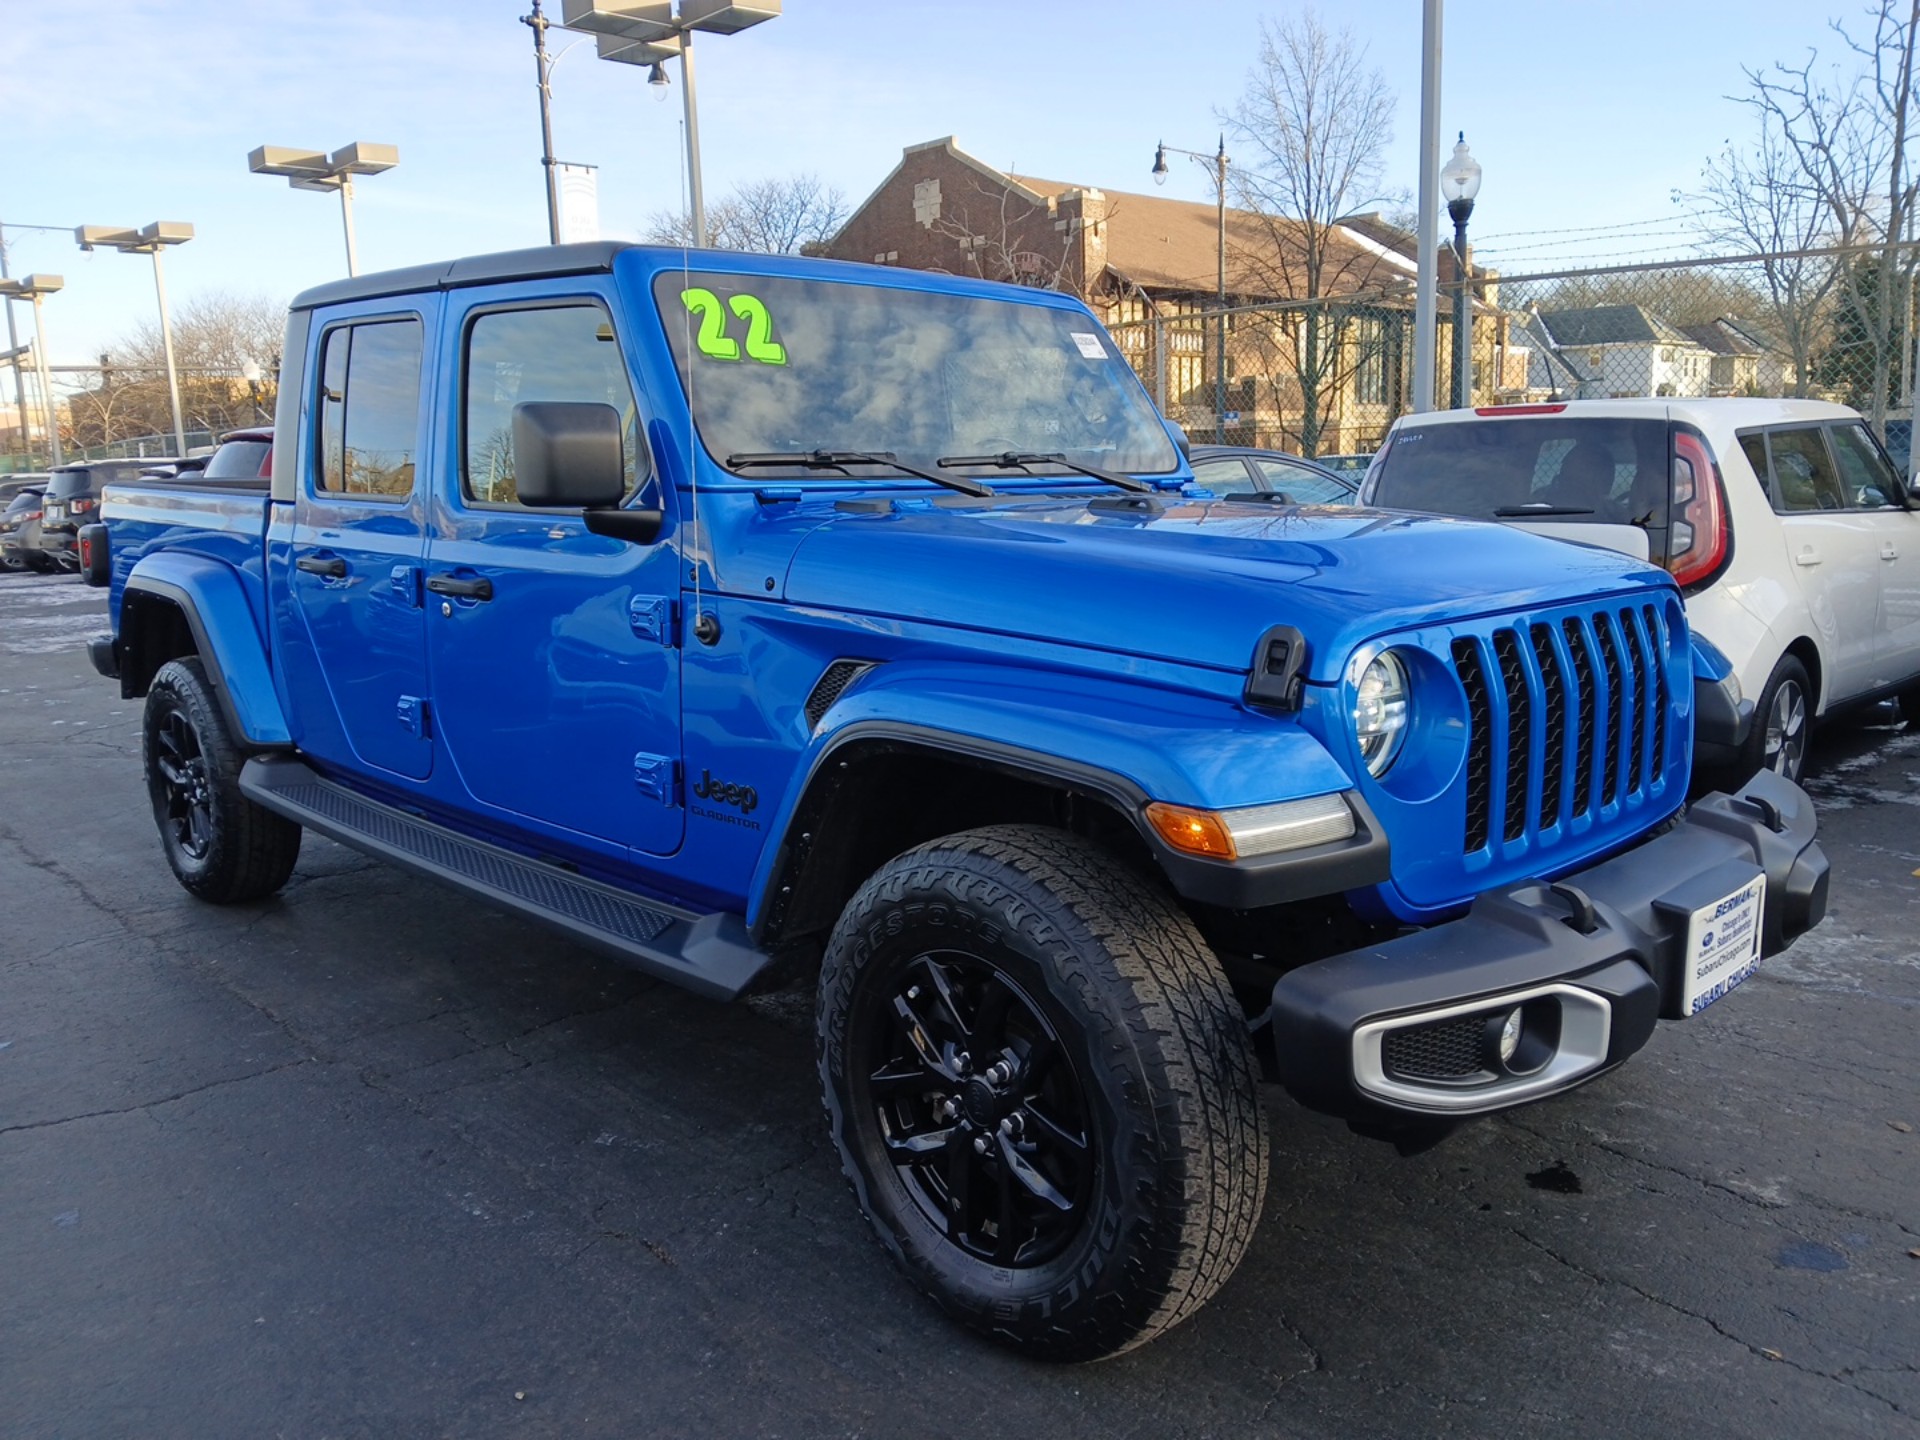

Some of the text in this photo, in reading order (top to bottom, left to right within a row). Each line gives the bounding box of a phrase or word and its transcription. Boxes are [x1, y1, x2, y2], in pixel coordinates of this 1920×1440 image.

[680, 287, 787, 366] 22
[693, 768, 758, 815] Jeep
[691, 805, 760, 832] GLADIATOR
[828, 902, 1003, 1079] BRIDGESTONE
[1692, 979, 1725, 1015] SUBARU
